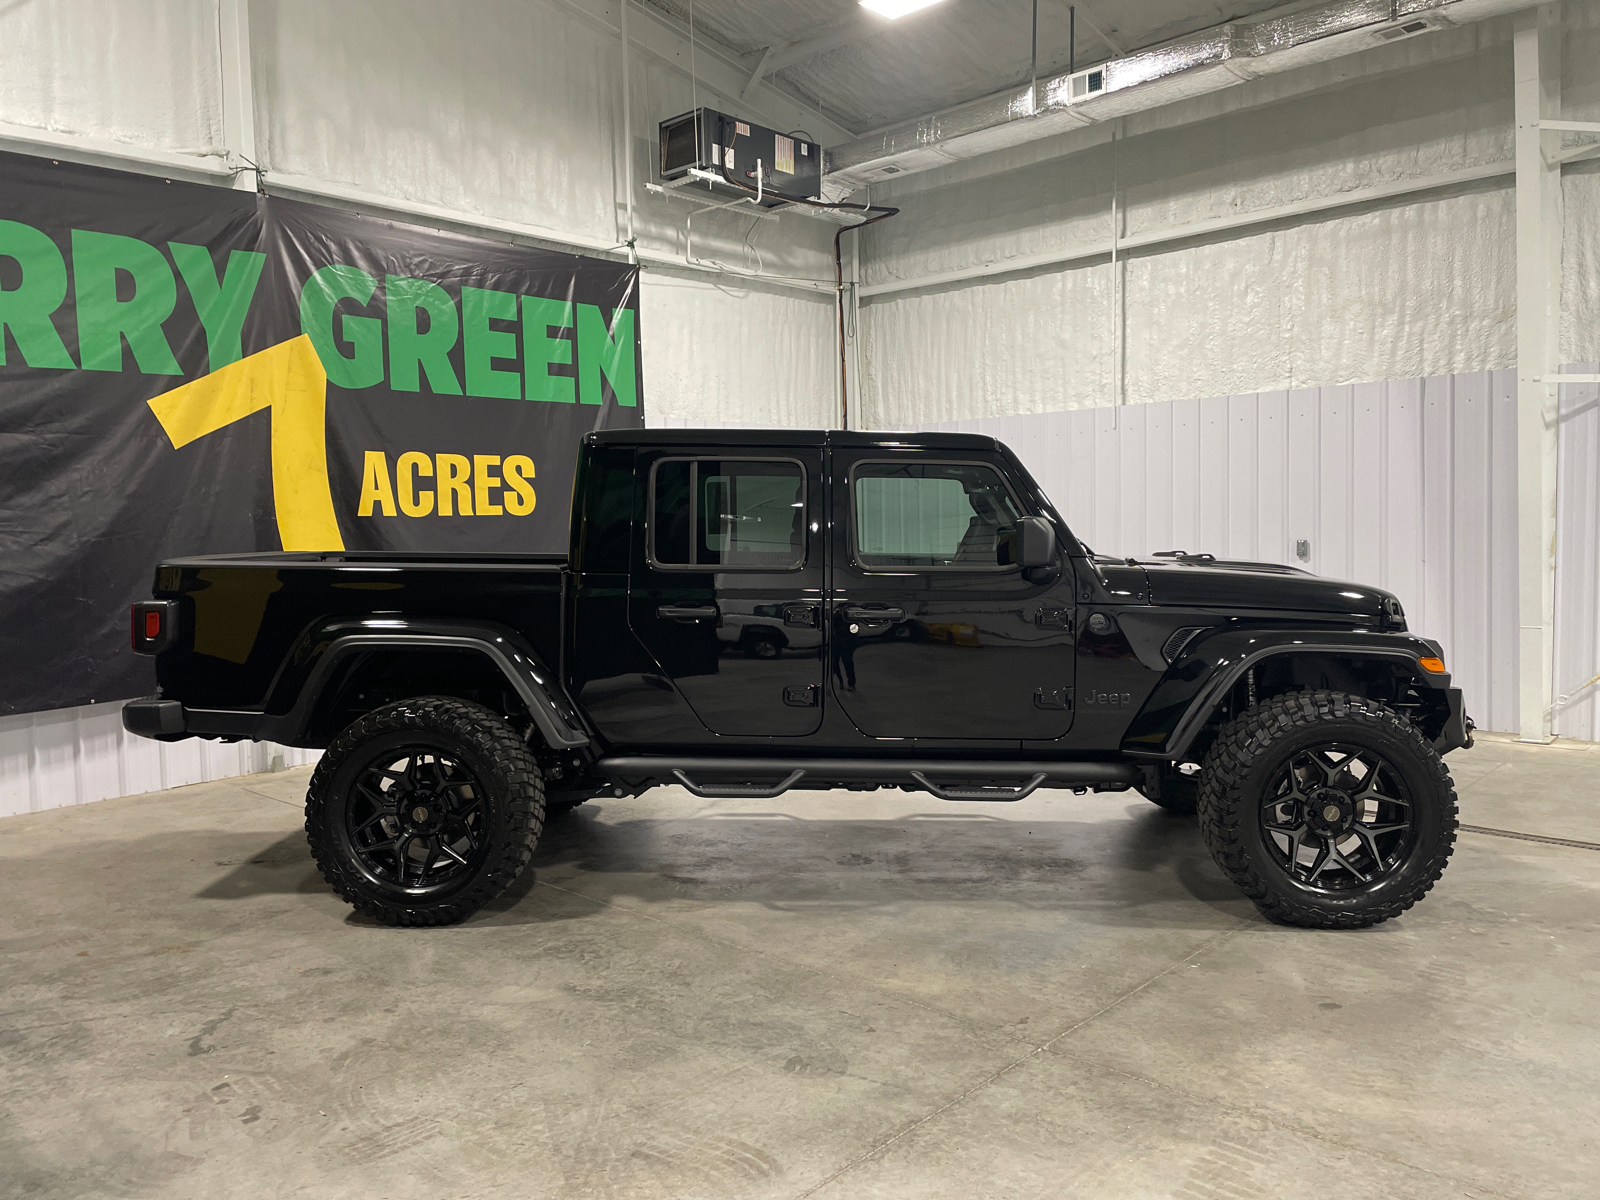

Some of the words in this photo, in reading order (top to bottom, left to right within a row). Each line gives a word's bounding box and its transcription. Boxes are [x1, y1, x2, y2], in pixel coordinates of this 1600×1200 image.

[300, 264, 637, 407] GREEN
[147, 333, 346, 552] 7
[357, 450, 537, 518] ACRES
[1084, 689, 1132, 708] Jeep
